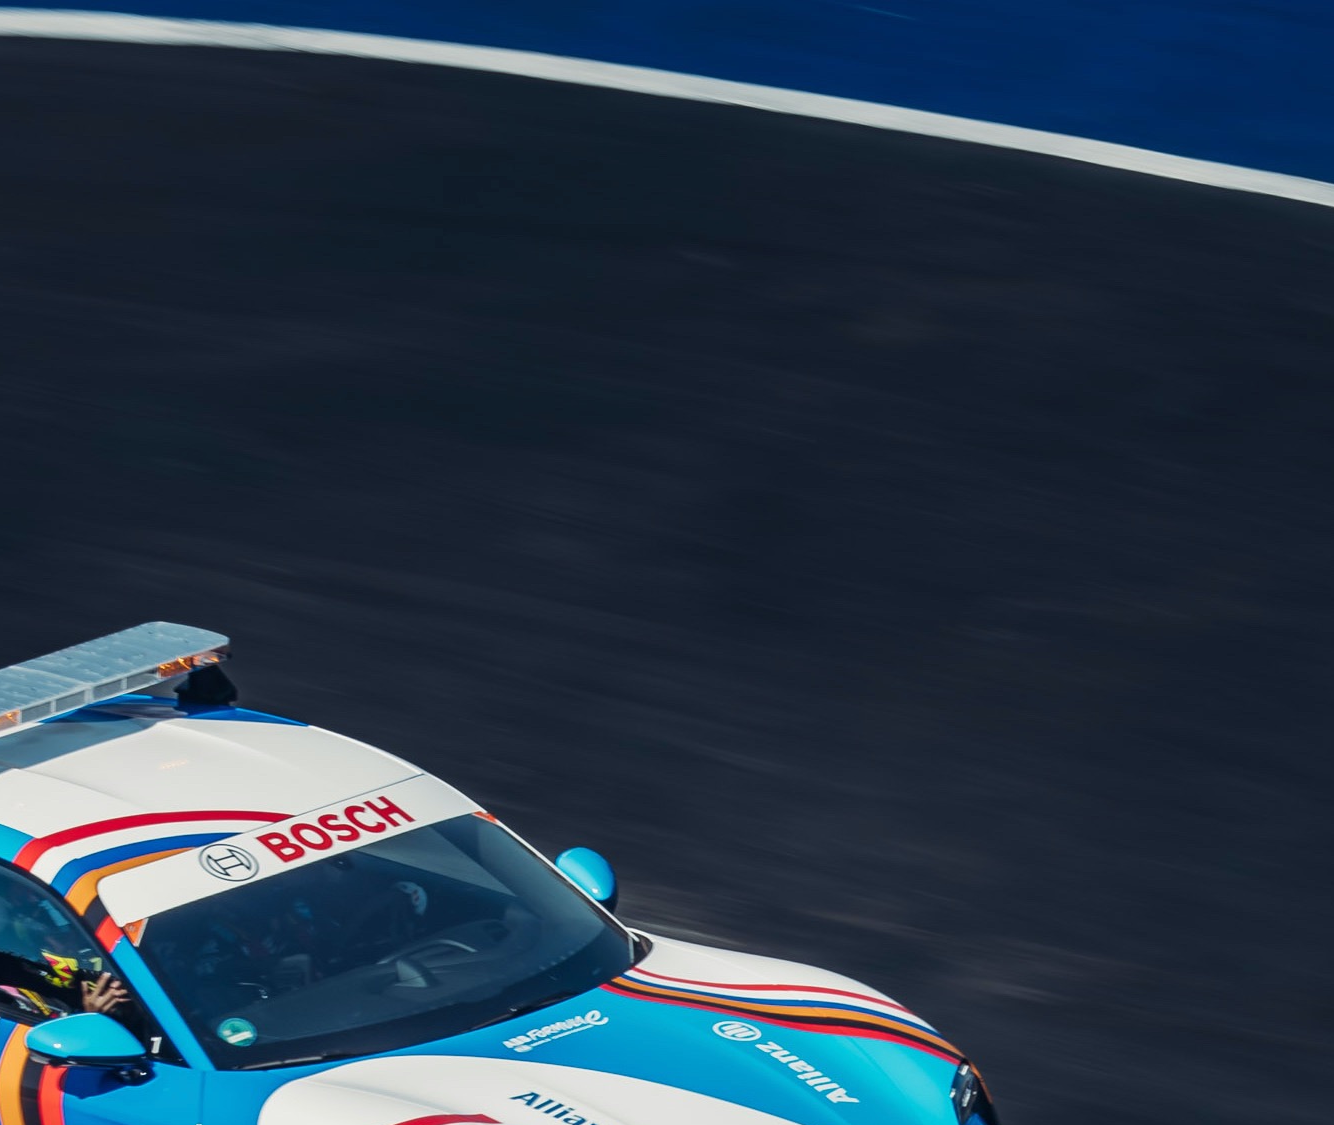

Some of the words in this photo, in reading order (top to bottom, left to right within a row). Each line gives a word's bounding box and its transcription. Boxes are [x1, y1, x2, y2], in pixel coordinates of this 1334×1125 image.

[255, 796, 417, 863] BOSCH
[150, 1036, 163, 1054] 1
[755, 1041, 860, 1104] Allianz
